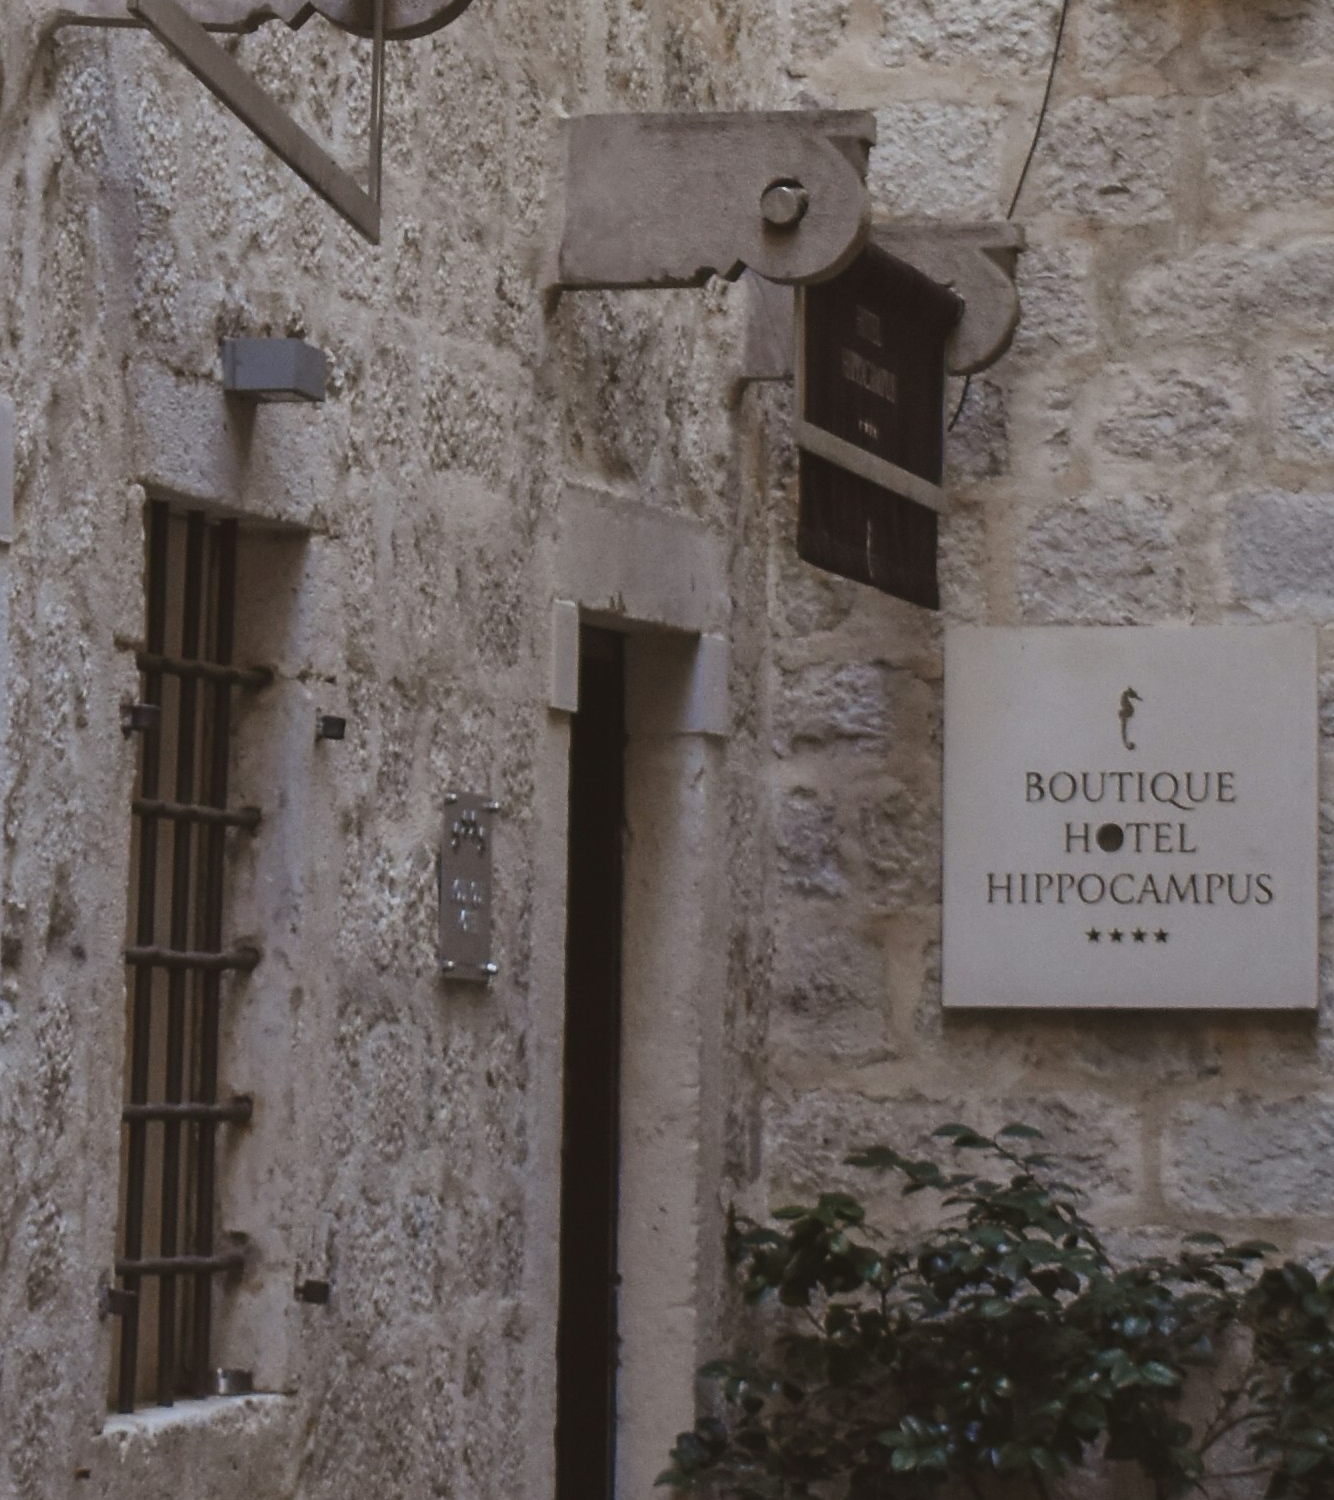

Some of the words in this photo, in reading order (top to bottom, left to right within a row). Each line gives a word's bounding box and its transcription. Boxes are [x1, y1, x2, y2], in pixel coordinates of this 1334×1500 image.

[1024, 771, 1237, 811] BOUTIQUE
[1063, 822, 1198, 854] HOTEL
[985, 873, 1275, 905] HIPPOCAMPUS
